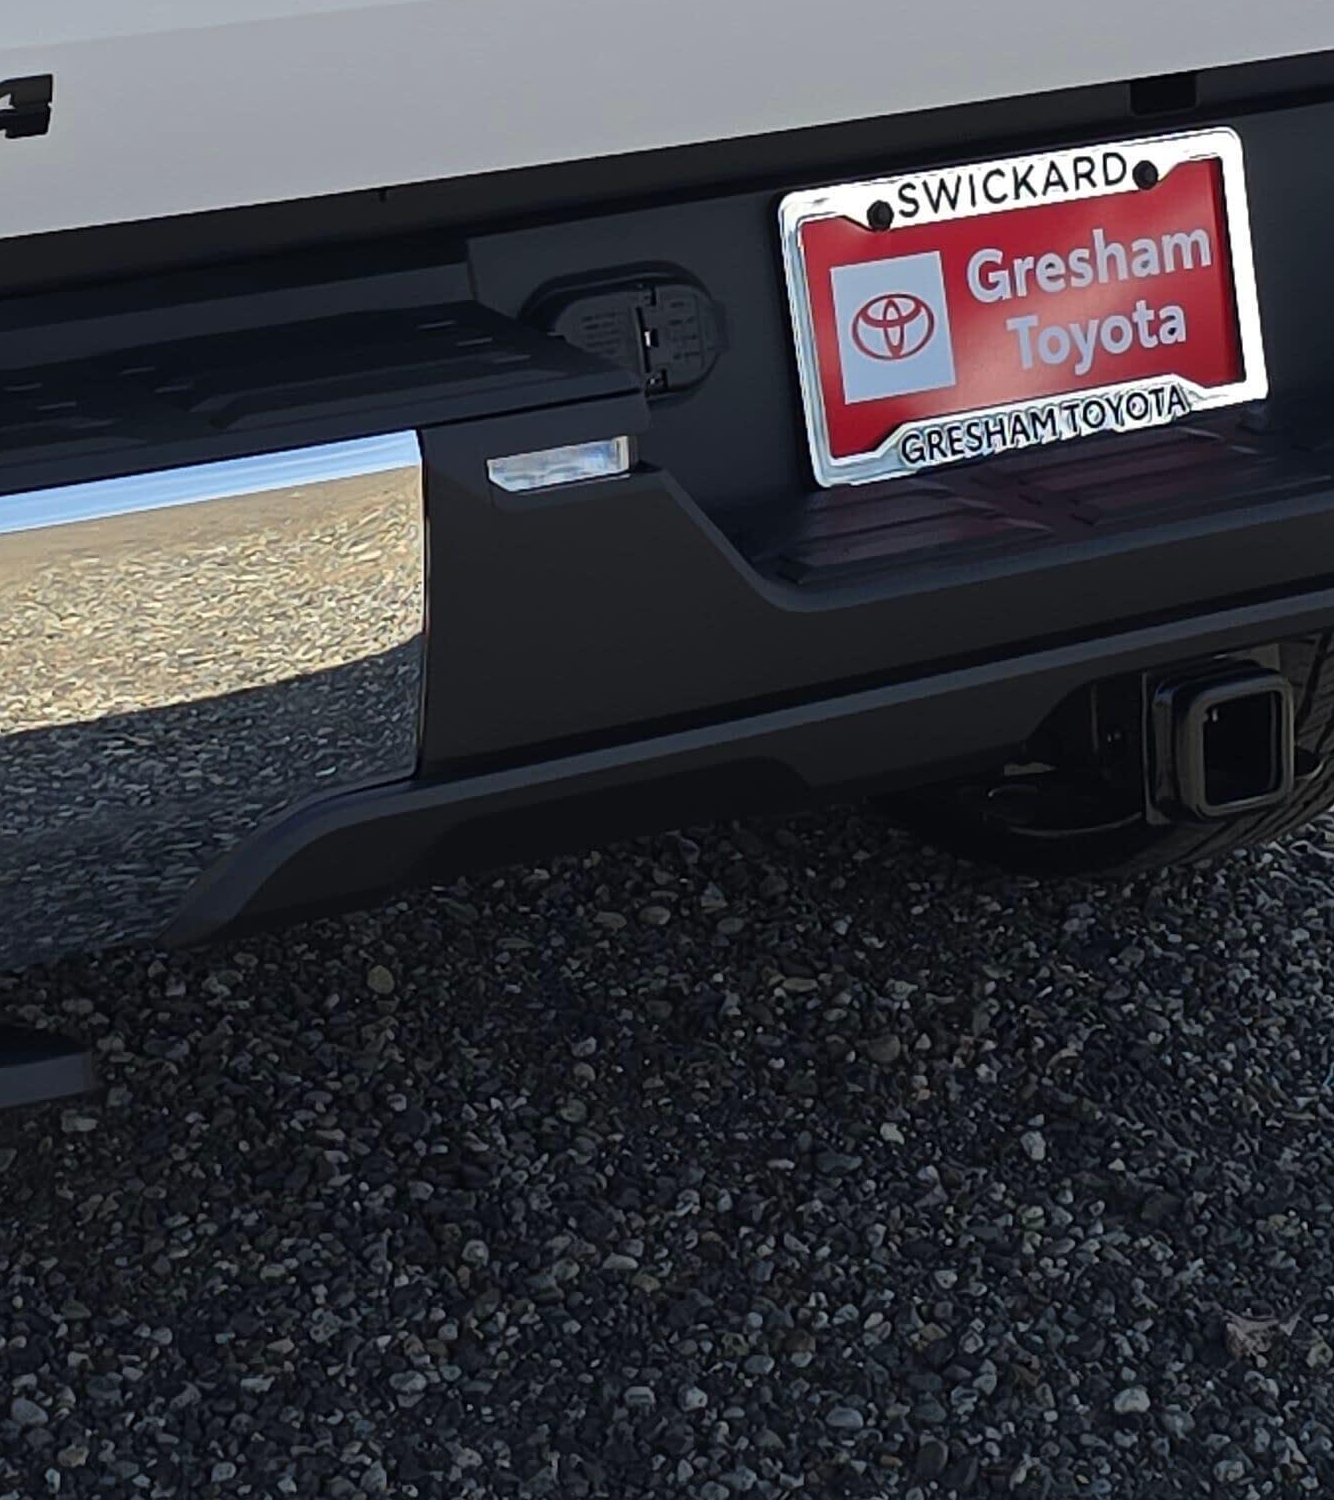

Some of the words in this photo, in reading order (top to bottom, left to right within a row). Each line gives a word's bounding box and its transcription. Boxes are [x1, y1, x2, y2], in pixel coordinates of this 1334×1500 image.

[897, 151, 1128, 218] SWICKARD
[966, 227, 1213, 303] Gresham
[1005, 299, 1187, 375] Toyota
[899, 408, 1059, 464] GRESHAM
[1062, 384, 1187, 432] TOYOTA
